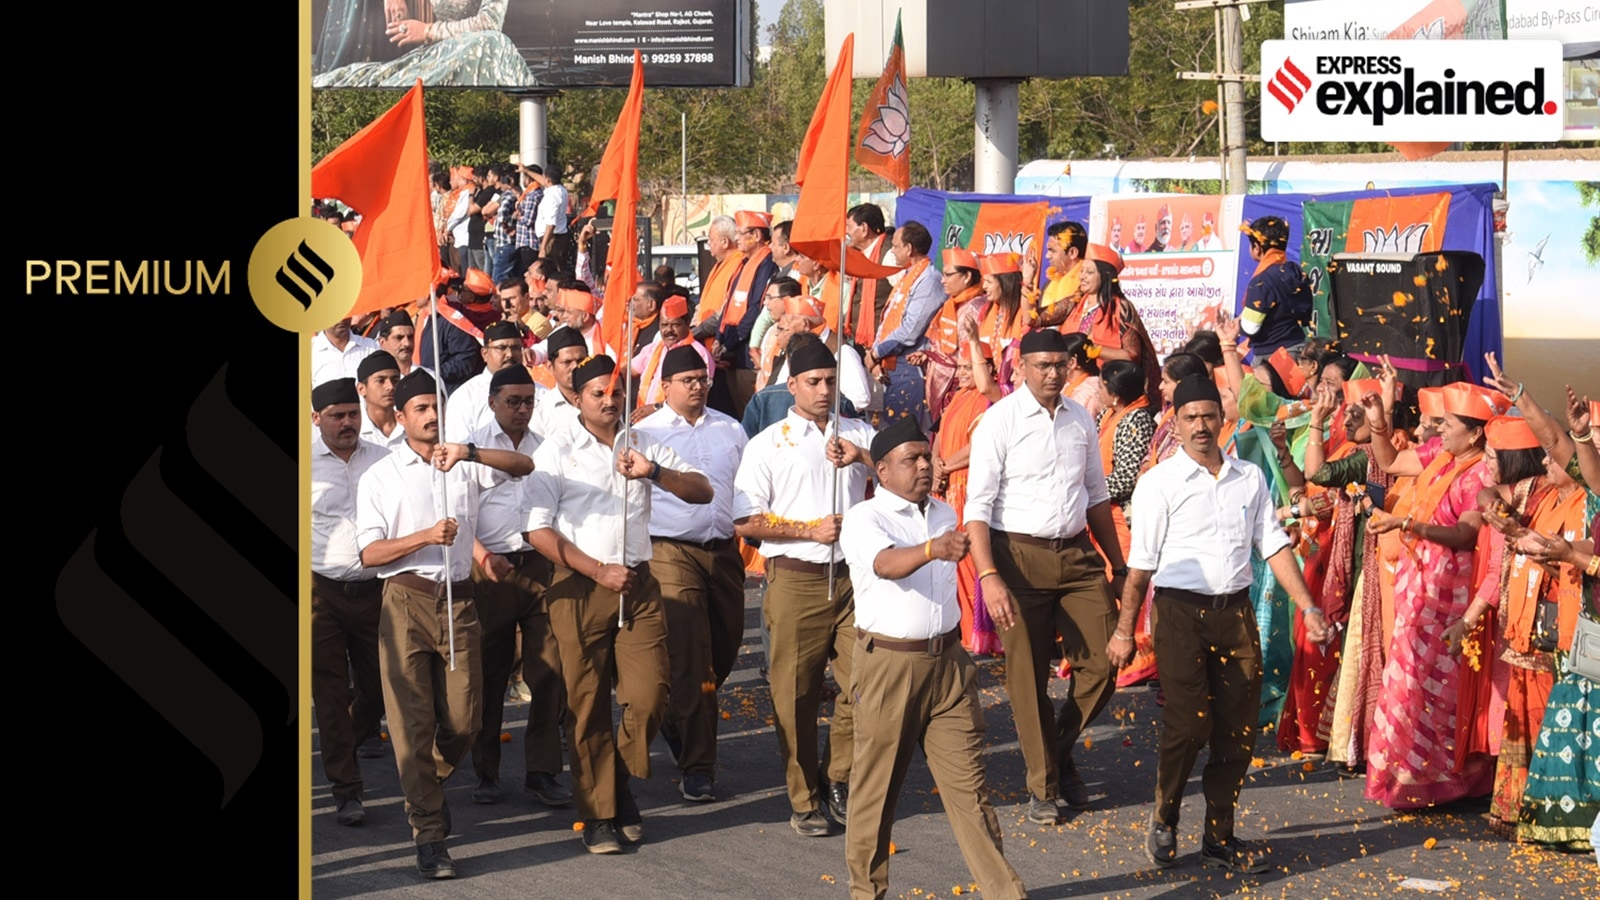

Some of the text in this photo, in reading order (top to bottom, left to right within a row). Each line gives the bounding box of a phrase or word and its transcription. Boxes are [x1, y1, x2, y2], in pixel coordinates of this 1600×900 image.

[655, 11, 669, 19] Shop
[613, 19, 632, 27] temple,
[673, 18, 692, 26] Rajkot,
[1292, 26, 1340, 40] Shivam
[1542, 9, 1581, 28] By-Pass
[574, 53, 714, 64] Manish Bhind 99259 37898
[1346, 263, 1402, 273] VASANT SOUND
